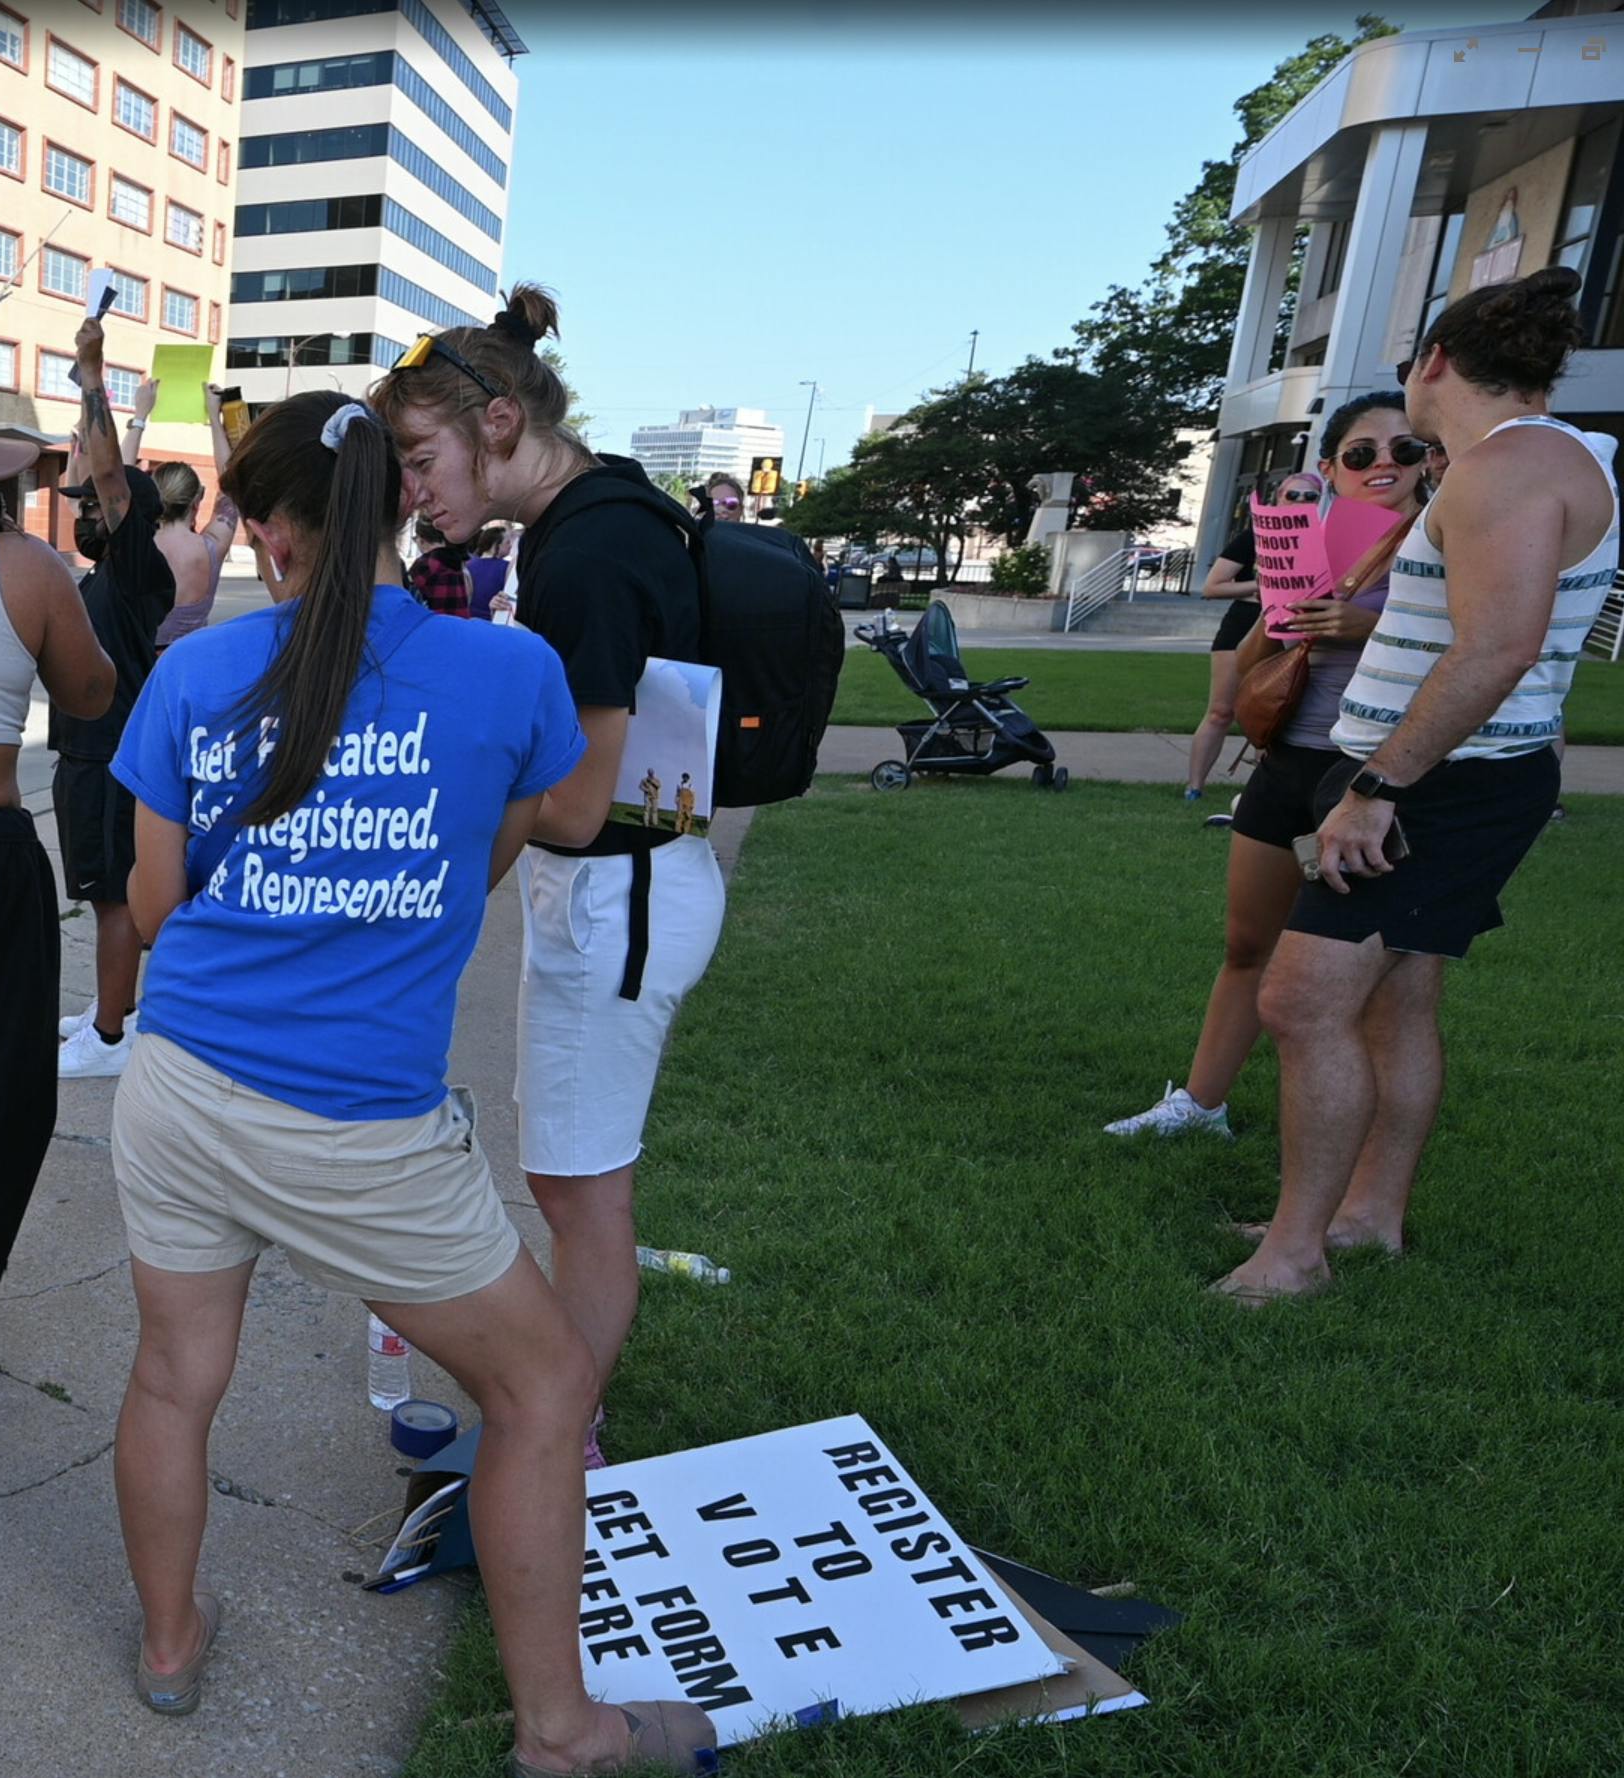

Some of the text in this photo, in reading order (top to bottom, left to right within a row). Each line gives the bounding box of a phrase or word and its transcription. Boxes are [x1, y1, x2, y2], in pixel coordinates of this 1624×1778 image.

[1252, 514, 1309, 530] REEDOM
[1256, 535, 1299, 550] THOUT
[190, 712, 431, 783] Get Ecated.
[240, 852, 449, 923] Represented.
[696, 1492, 842, 1659] VOTE
[793, 1521, 873, 1580] TO
[822, 1440, 1020, 1652] REGISTER
[586, 1490, 753, 1712] GET FORM
